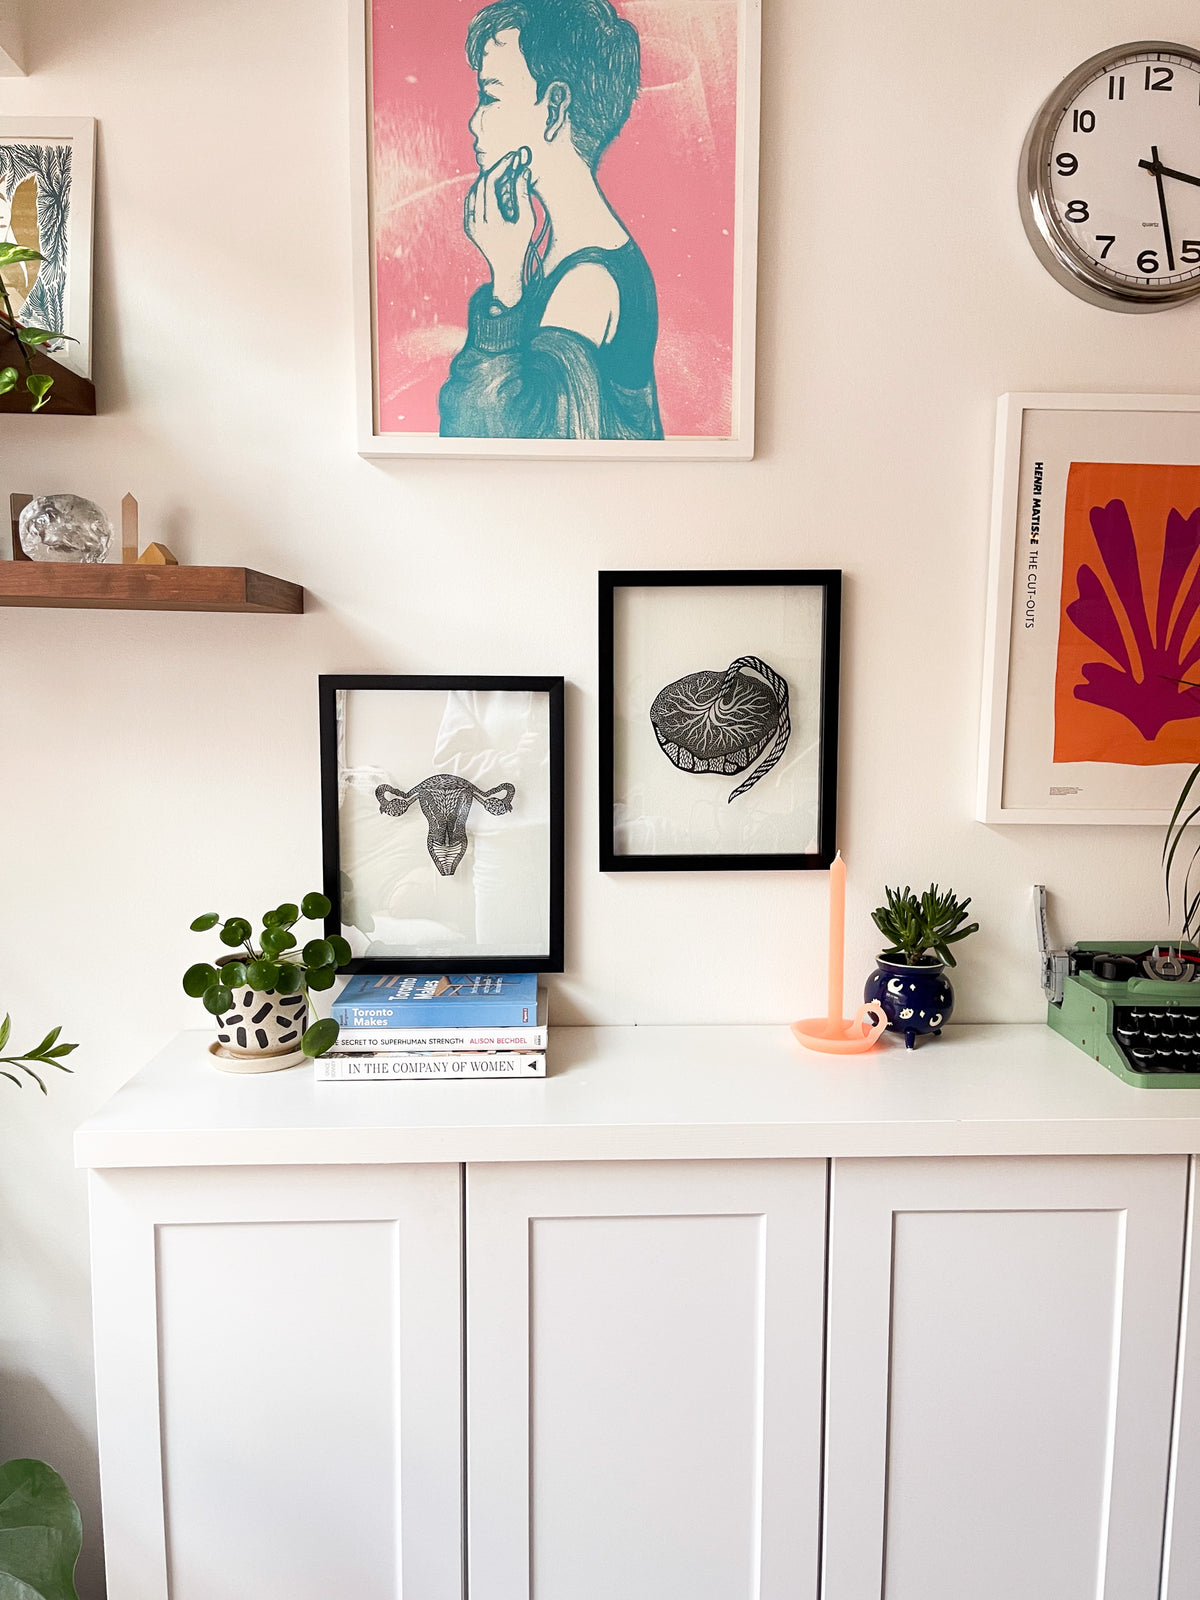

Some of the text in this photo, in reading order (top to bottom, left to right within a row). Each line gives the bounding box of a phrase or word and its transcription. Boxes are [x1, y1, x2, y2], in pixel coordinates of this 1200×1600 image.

[1108, 75, 1125, 100] 11
[1144, 65, 1174, 91] 12
[1072, 109, 1096, 133] 10
[1056, 152, 1079, 176] 9
[1064, 199, 1090, 223] 8
[1095, 235, 1116, 259] 7
[1180, 240, 1200, 263] 5
[1136, 249, 1160, 274] 6
[1025, 461, 1043, 629] HENRI MATISSE THE CUT-OUTS
[388, 977, 418, 1001] Toronto
[413, 980, 440, 1000] Makes
[352, 1008, 394, 1017] Toronto
[353, 1017, 388, 1026] Makes
[348, 1063, 361, 1074] IN
[364, 1062, 389, 1074] THE
[392, 1062, 449, 1073] COMPANY
[451, 1061, 468, 1073] OF
[470, 1060, 515, 1072] WOMEN
